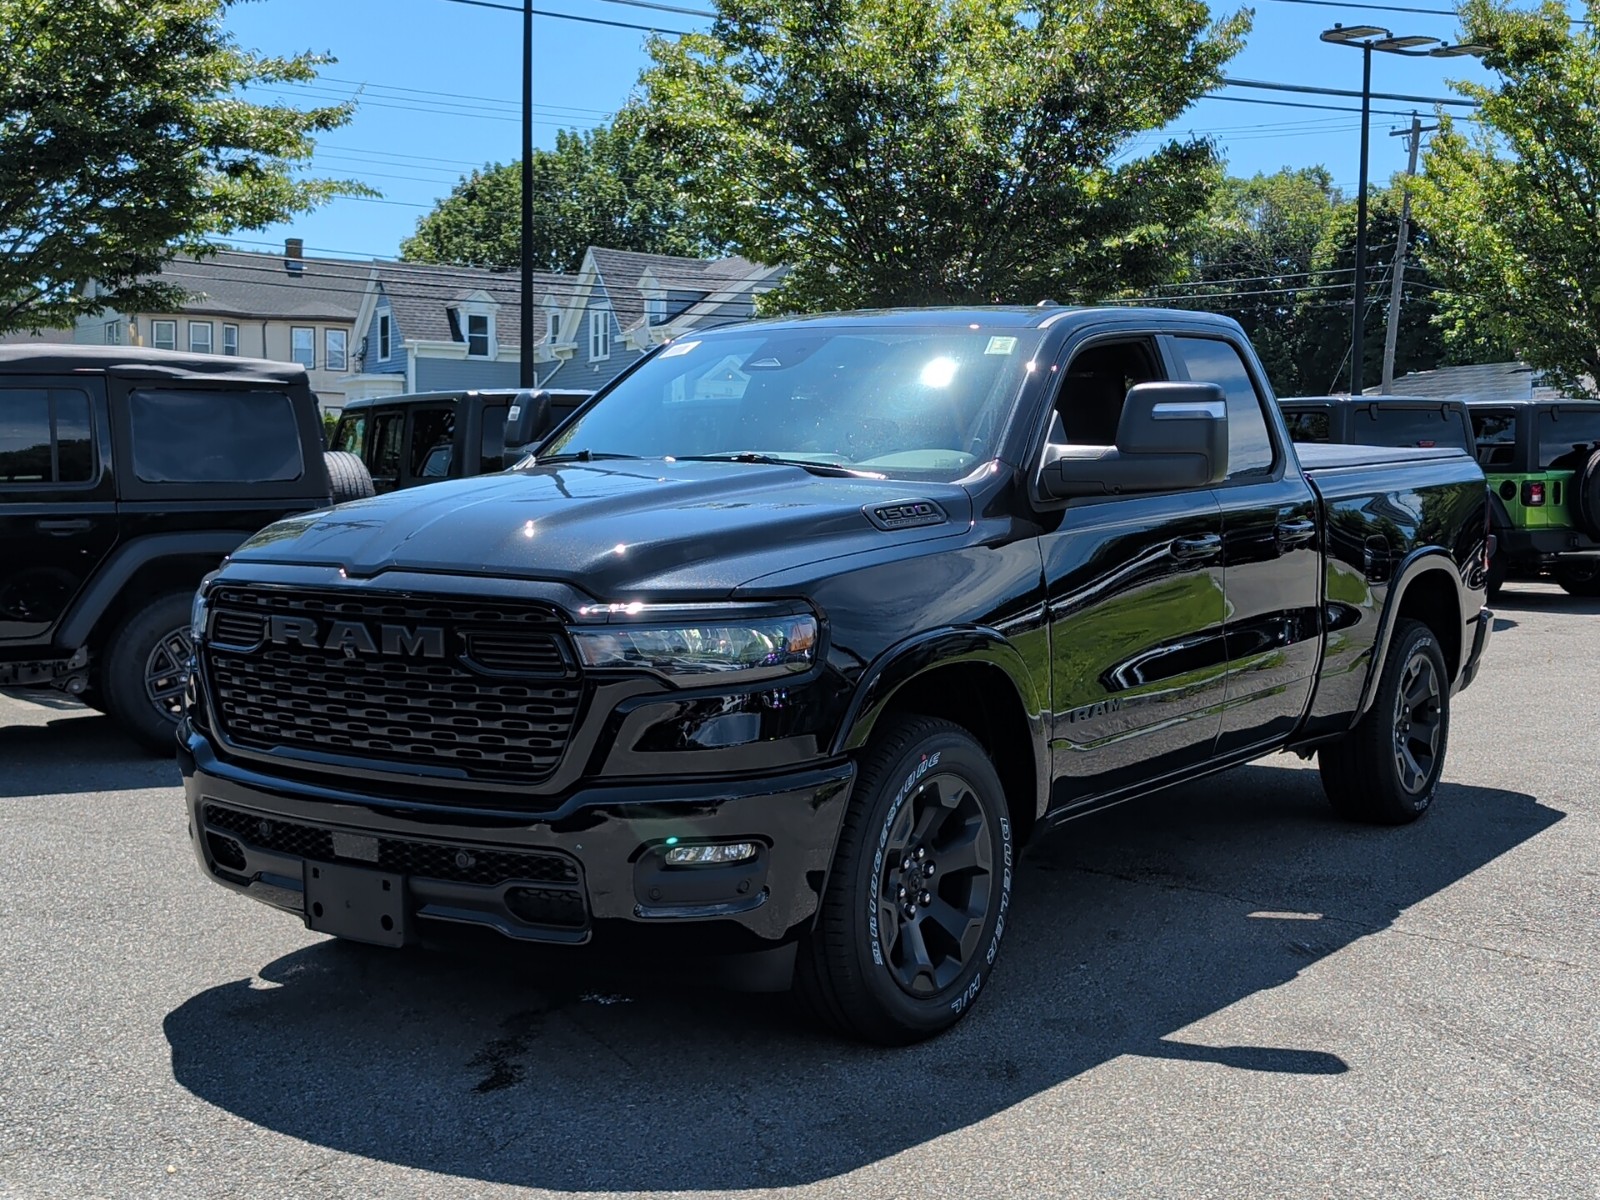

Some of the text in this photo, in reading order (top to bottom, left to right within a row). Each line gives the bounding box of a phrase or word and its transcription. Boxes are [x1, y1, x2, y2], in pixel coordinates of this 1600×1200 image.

[878, 504, 932, 520] 1500
[271, 615, 445, 658] RAM
[1070, 698, 1122, 723] RAM
[986, 817, 1012, 966] DUELER
